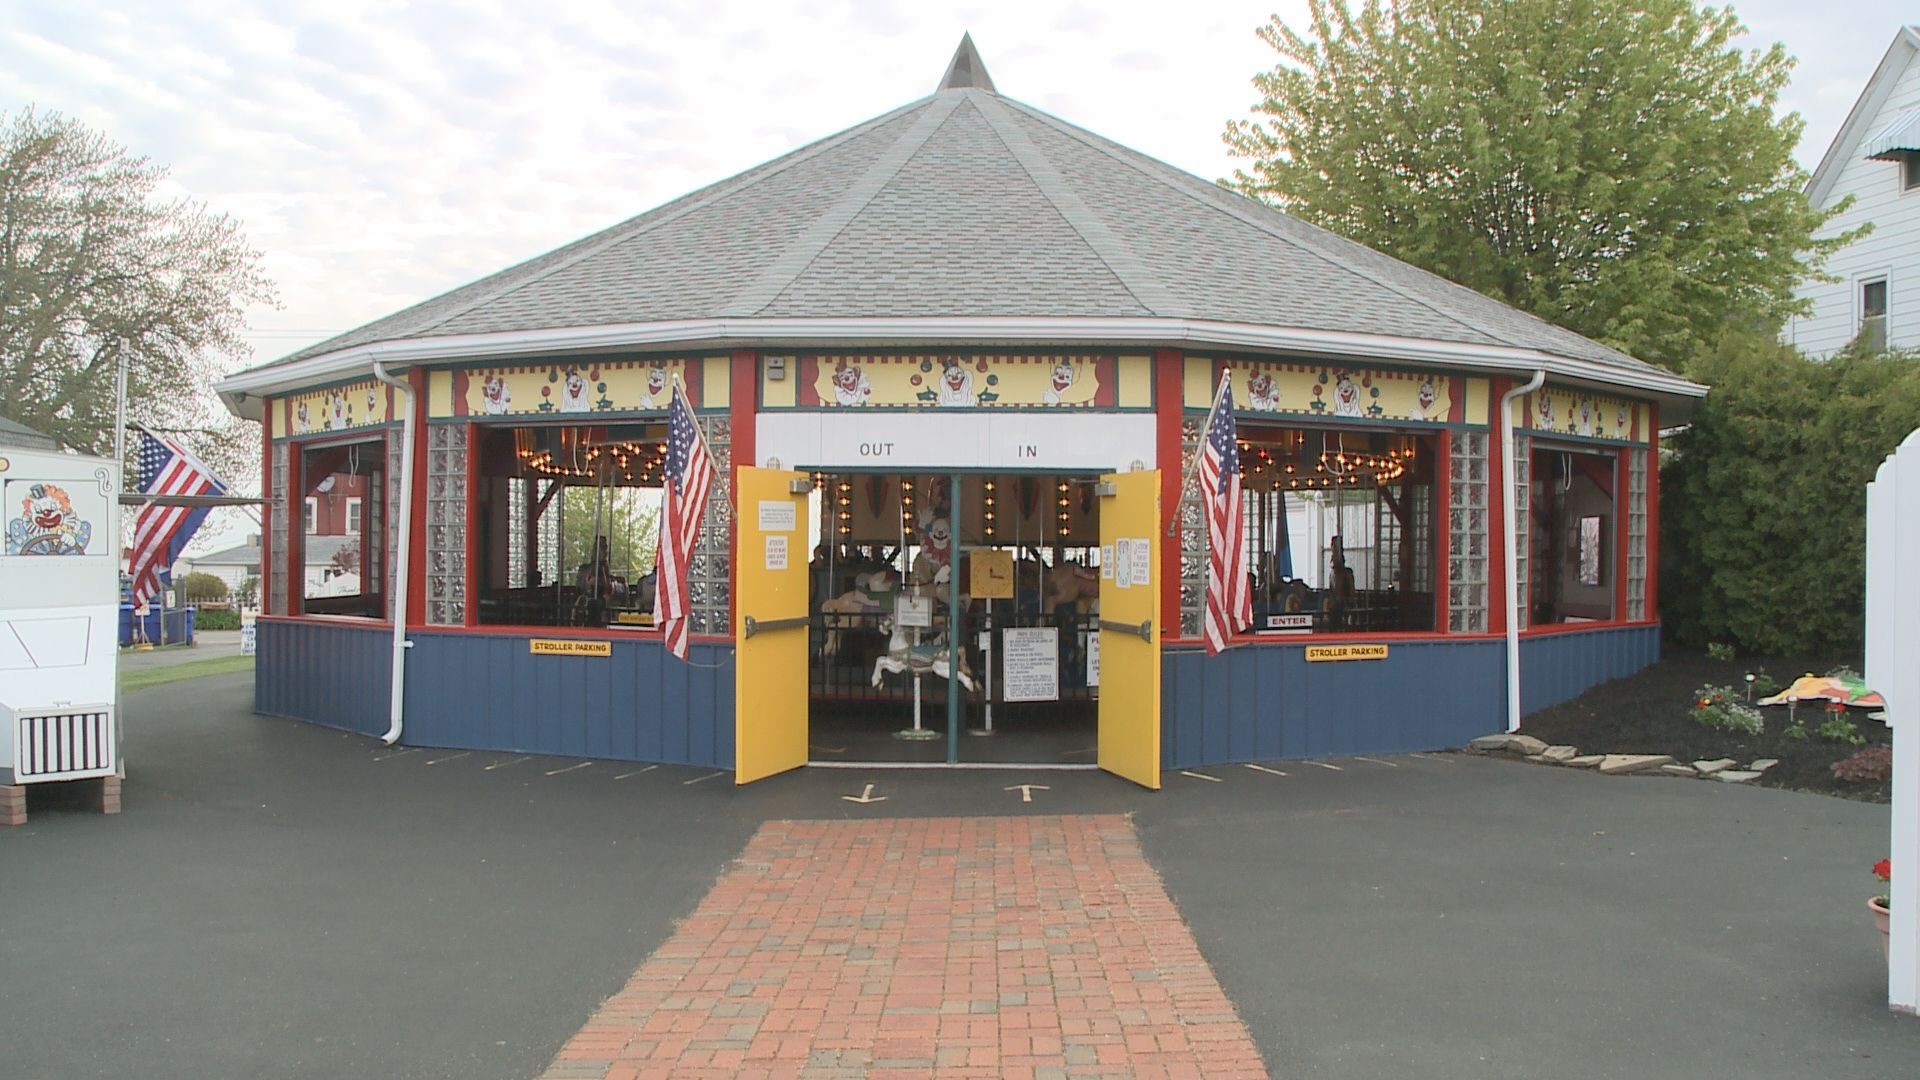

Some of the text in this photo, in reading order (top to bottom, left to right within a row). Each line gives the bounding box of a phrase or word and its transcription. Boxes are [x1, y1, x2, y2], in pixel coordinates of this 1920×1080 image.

[859, 442, 894, 457] OUT
[1018, 445, 1037, 458] IN
[1272, 616, 1306, 625] ENTER
[534, 642, 607, 652] STROLLER PARKING
[1310, 646, 1385, 657] STROLLER PARKING
